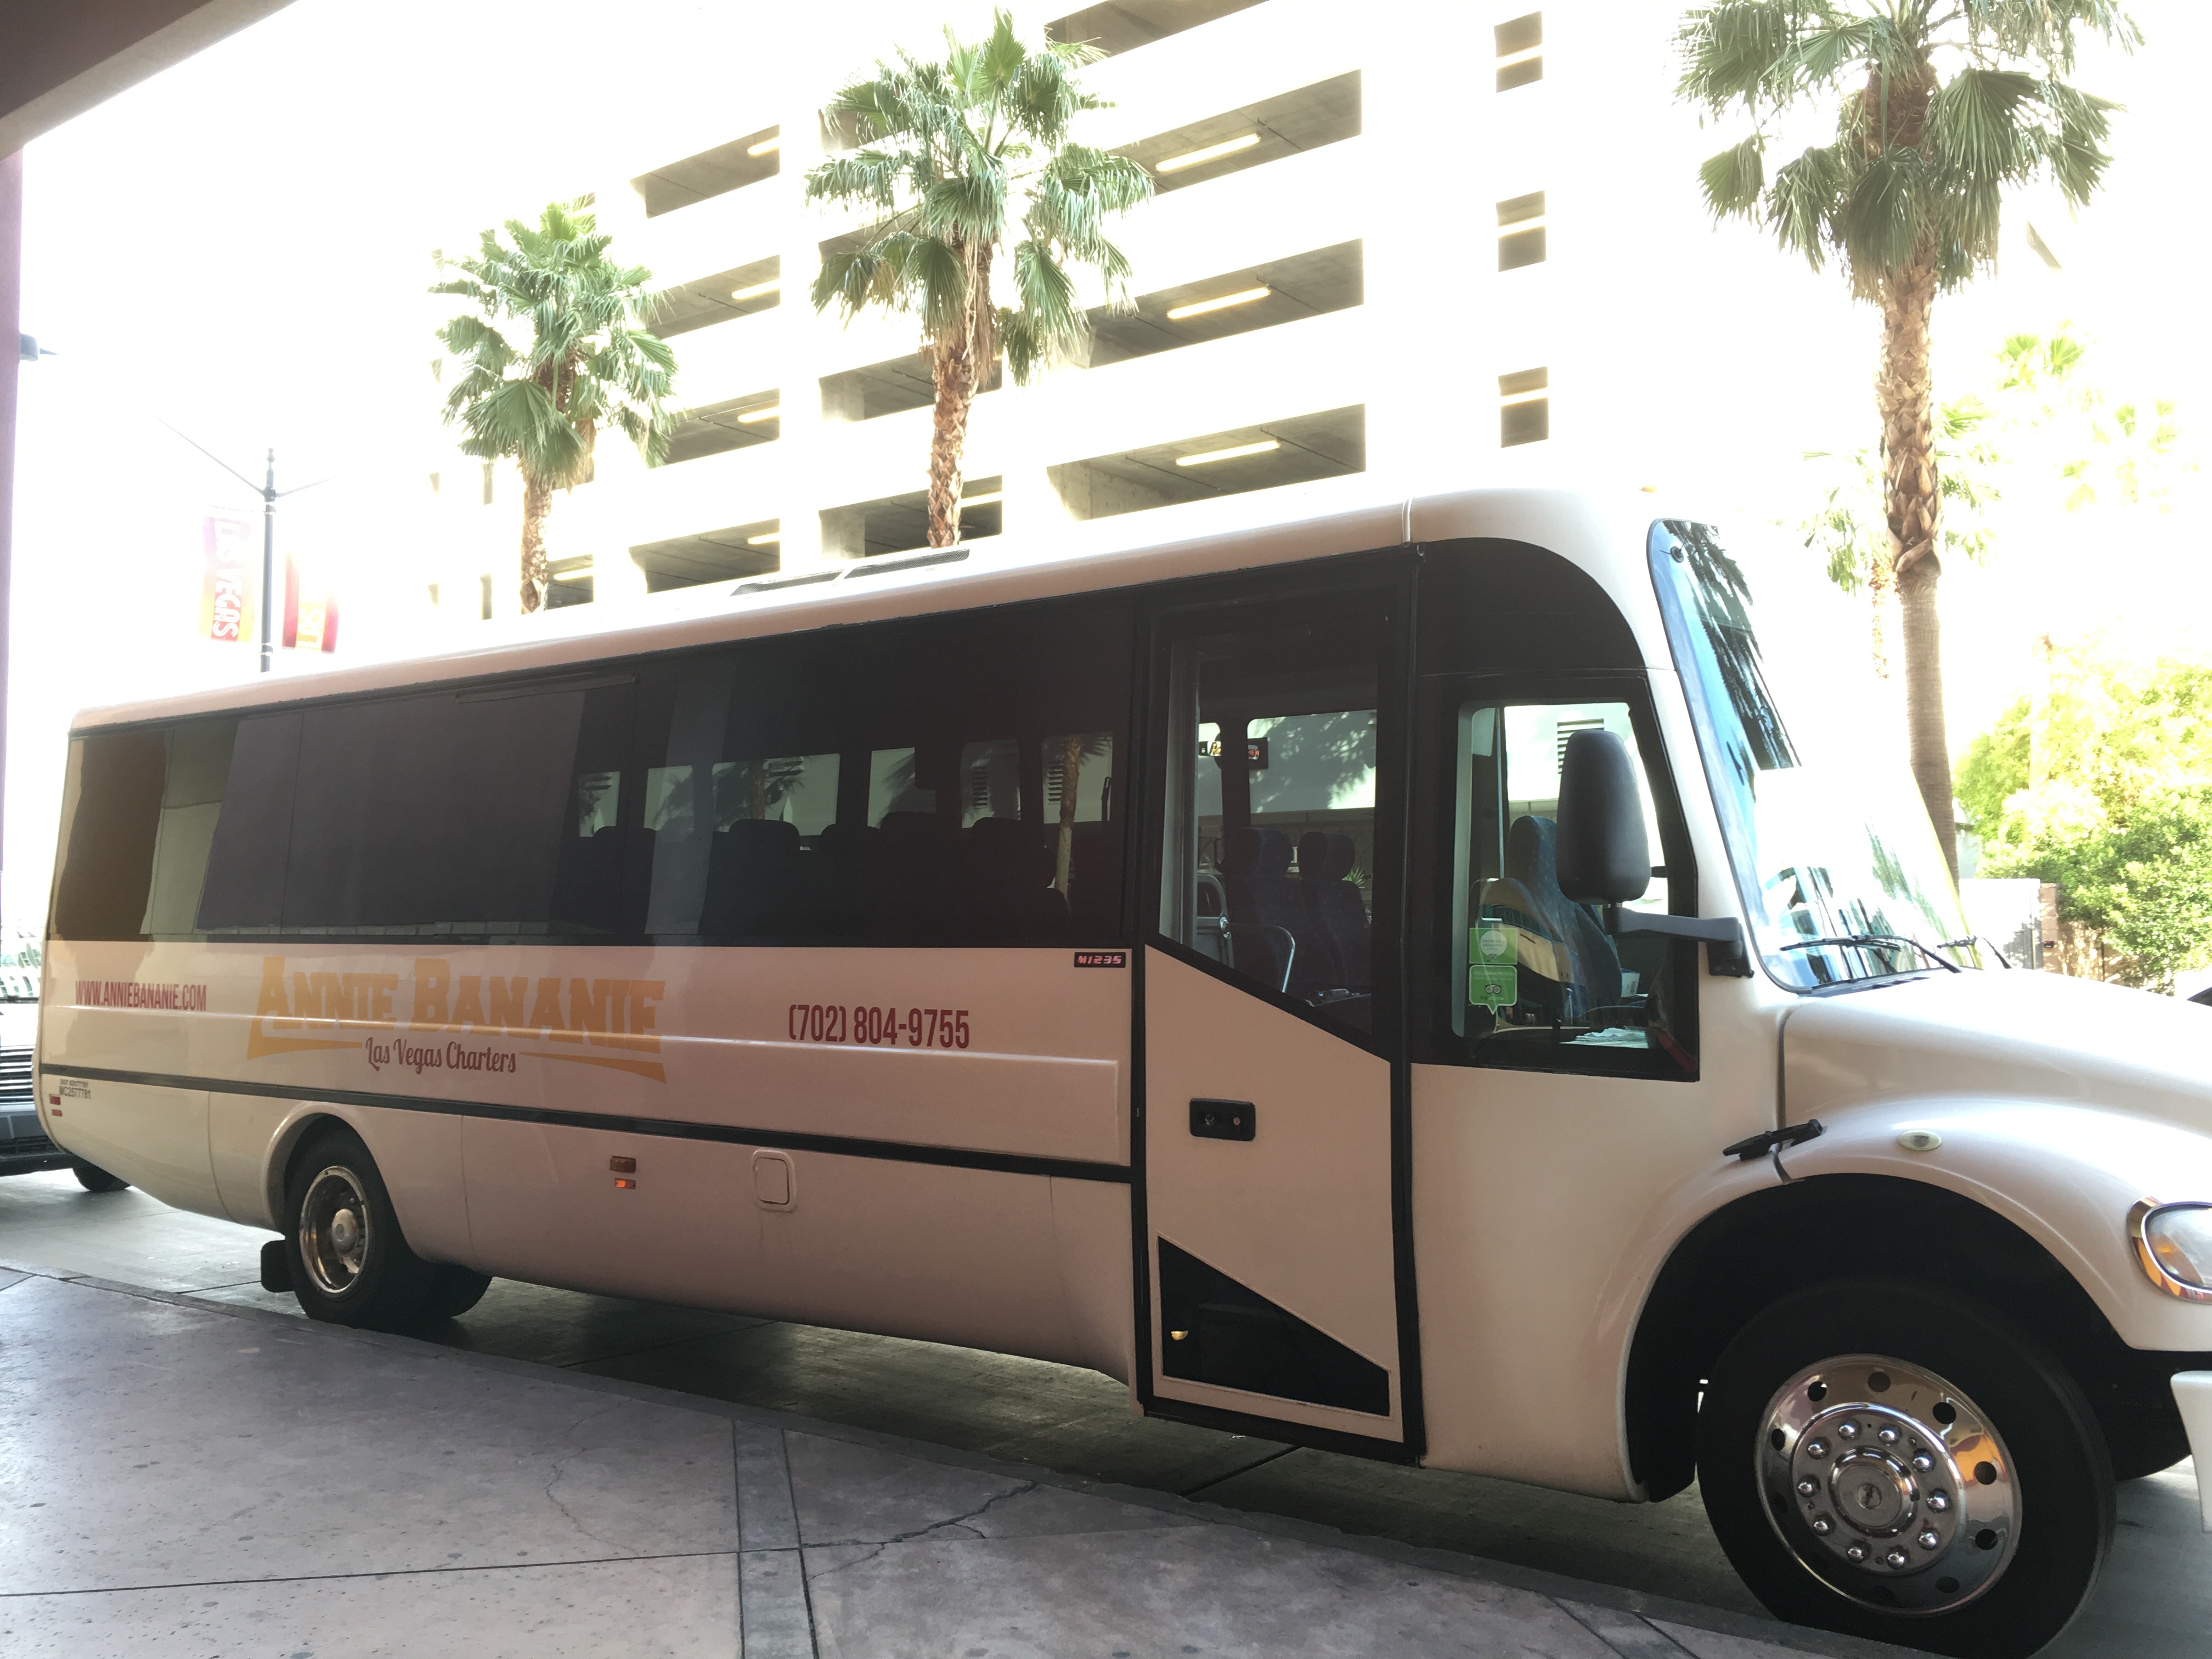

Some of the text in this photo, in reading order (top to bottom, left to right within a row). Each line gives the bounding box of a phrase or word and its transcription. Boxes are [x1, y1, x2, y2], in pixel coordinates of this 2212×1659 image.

[212, 521, 242, 637] LS VEGAS
[1077, 955, 1122, 964] M1235
[75, 980, 206, 1011] WWW.ANNIEBANANIE.COM
[250, 957, 667, 1054] ANNIE BANANIE
[789, 1005, 969, 1048] (702) 804-9755
[365, 1037, 516, 1075] Las Vegas Charters
